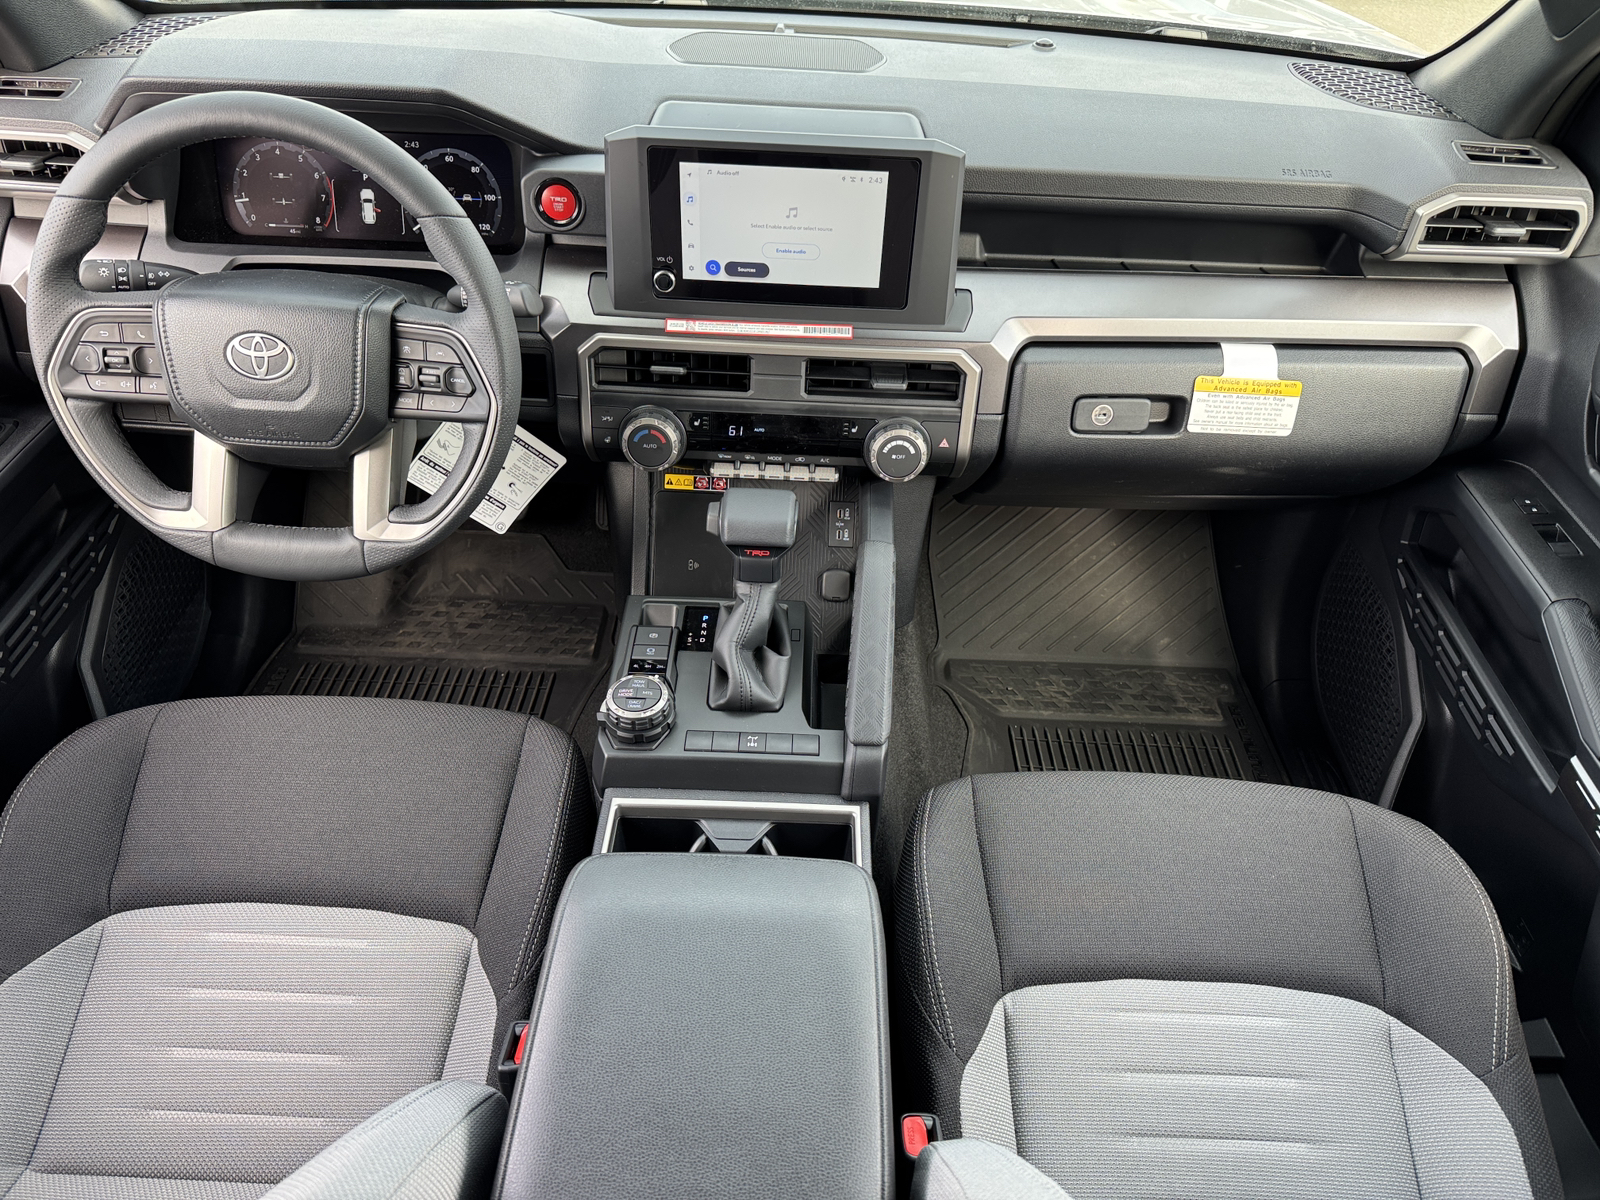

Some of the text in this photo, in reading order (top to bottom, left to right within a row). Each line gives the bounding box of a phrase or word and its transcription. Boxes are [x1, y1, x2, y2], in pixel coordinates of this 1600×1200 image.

[362, 173, 368, 181] P
[1300, 169, 1332, 178] AIRBAG
[907, 1127, 915, 1145] PRESS
